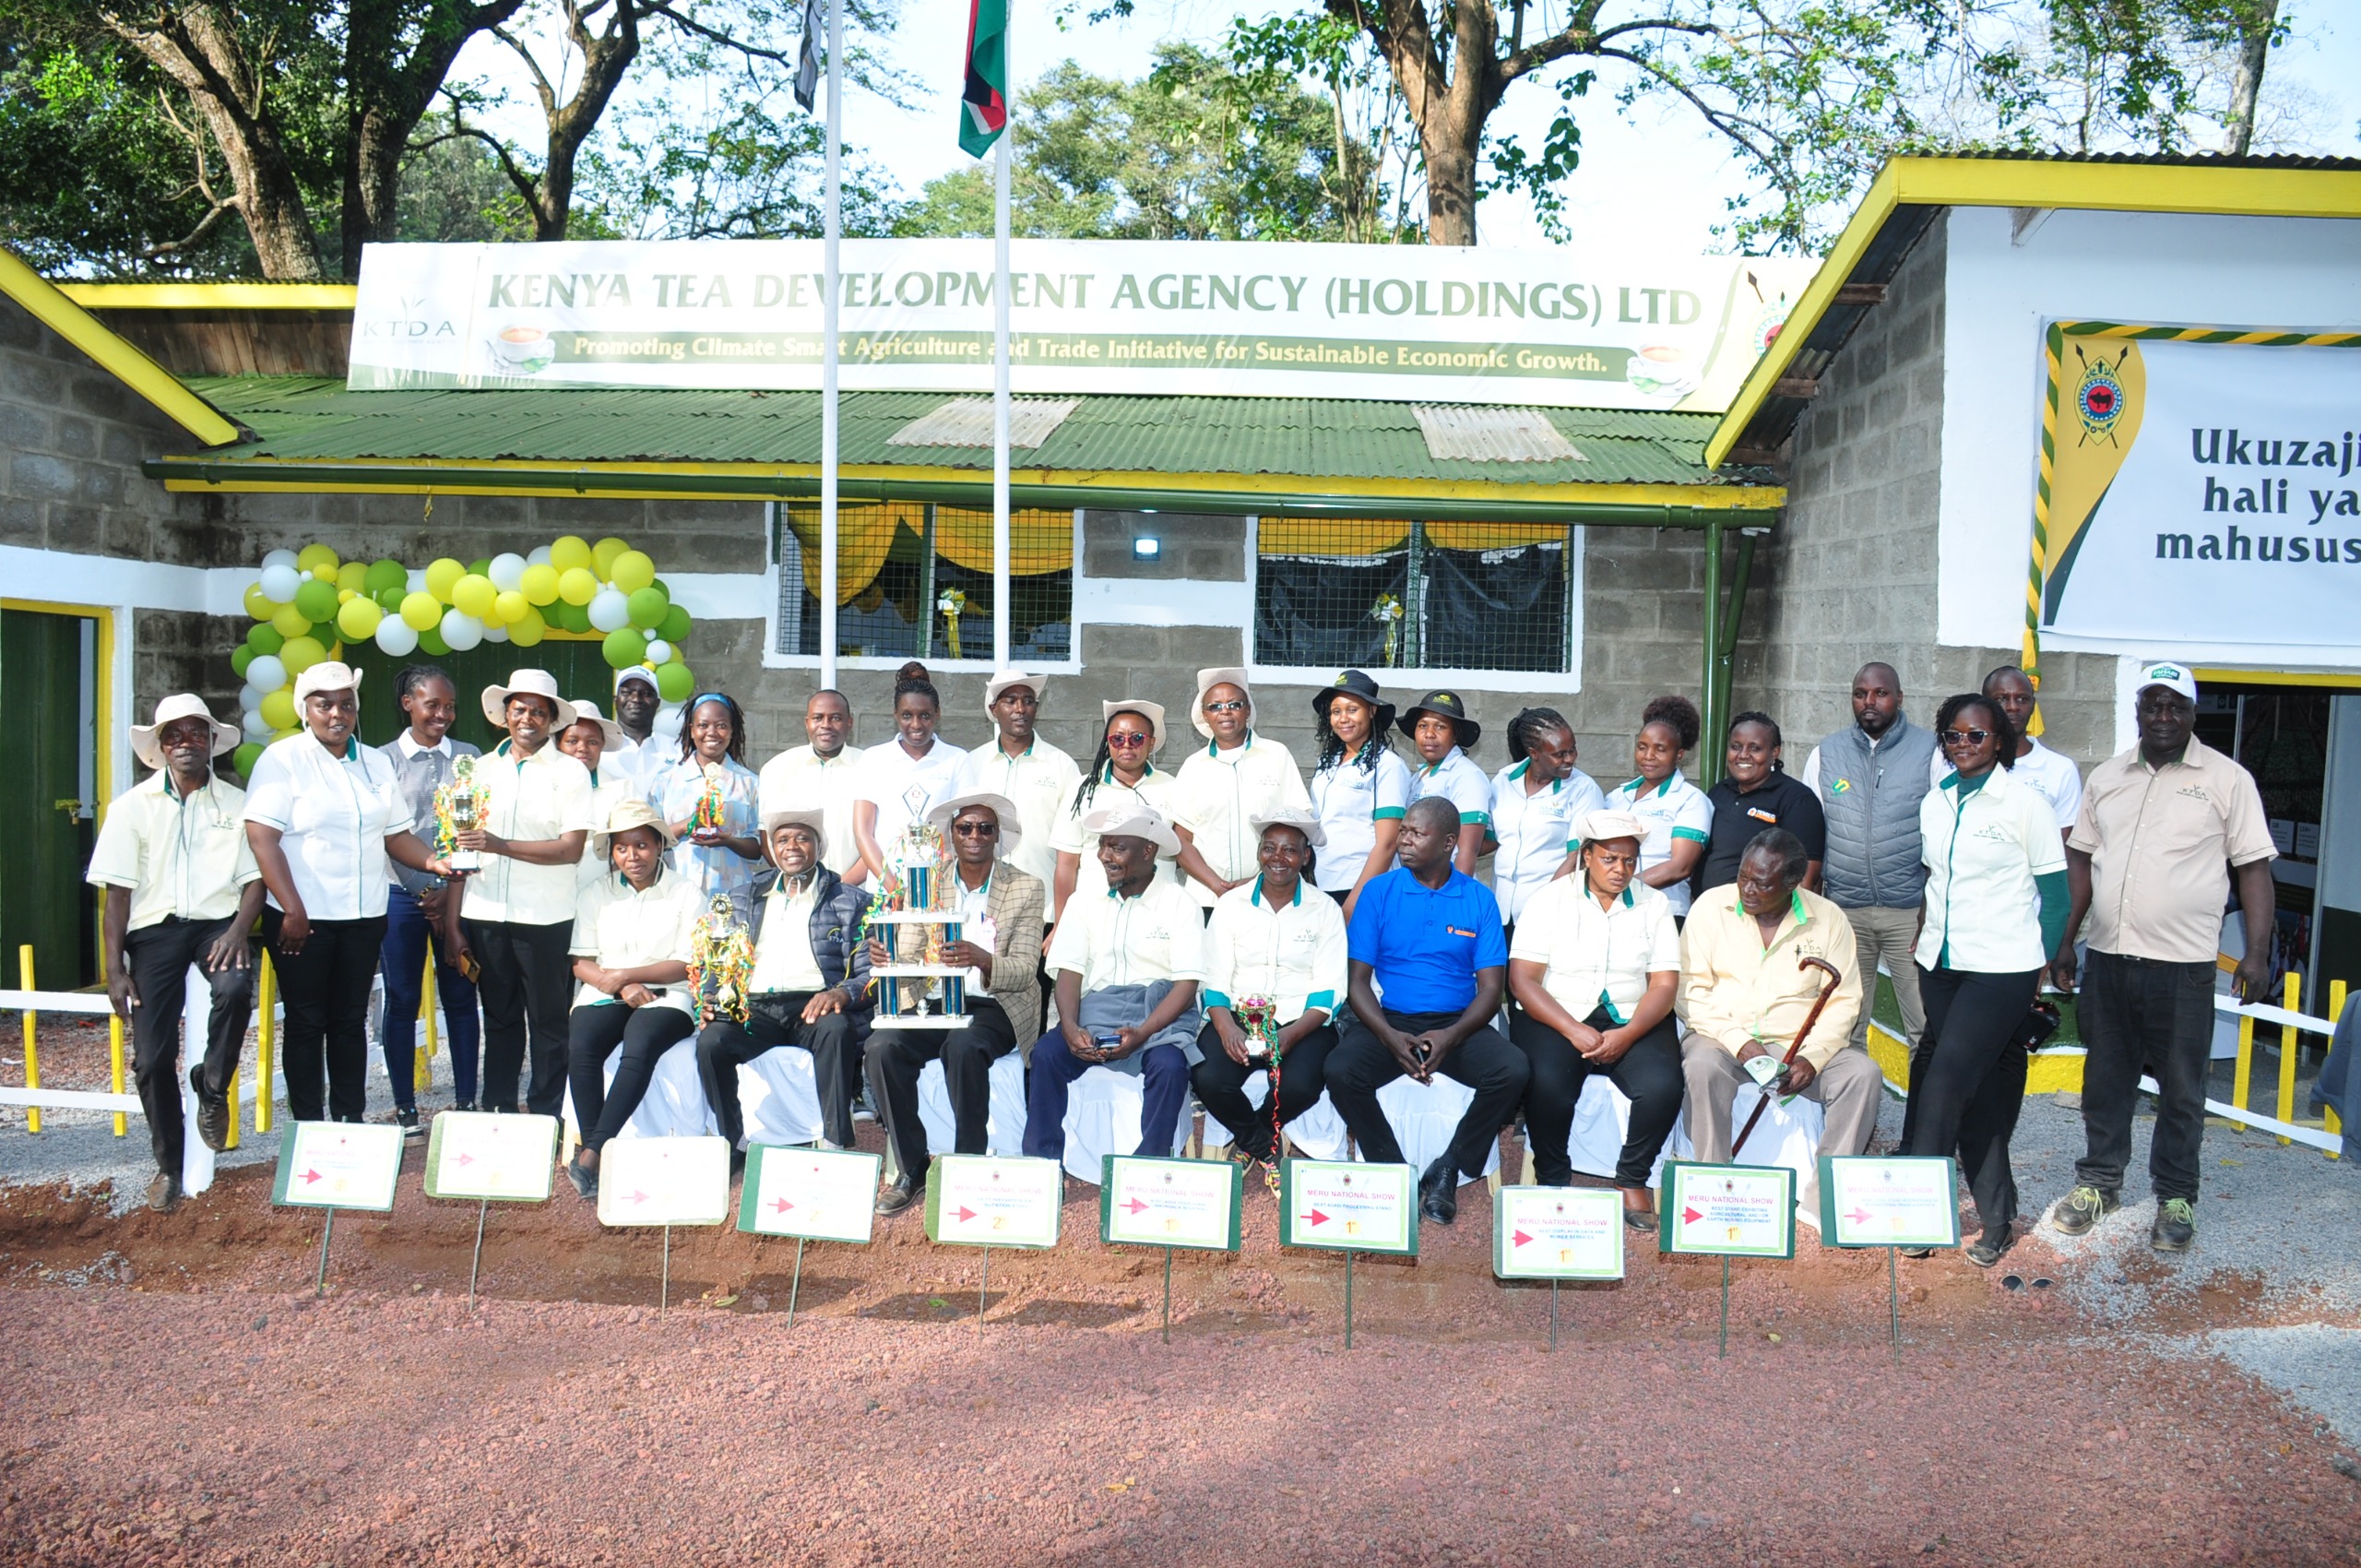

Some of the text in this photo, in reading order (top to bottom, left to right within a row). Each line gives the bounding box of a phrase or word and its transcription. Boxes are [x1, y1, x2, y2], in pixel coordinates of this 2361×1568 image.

[488, 271, 1702, 327] KENYA TEA DEVELOPMENT AGENCY (HOLDINGS) LTD
[362, 320, 457, 337] KTDA
[575, 337, 685, 360] Promoting
[692, 337, 776, 356] Climate
[782, 337, 846, 357] Smat
[854, 337, 980, 360] Agriculture
[1038, 339, 1100, 358] Trade
[1108, 339, 1207, 359] Initiative
[1216, 340, 1249, 360] for
[1255, 341, 1389, 365] Sustainable
[1397, 347, 1509, 368] Economic
[1516, 350, 1608, 372] Growth.
[2203, 477, 2361, 526] hali ya
[2155, 526, 2361, 564] mahusus
[1150, 1187, 1187, 1196] NATIONAL
[1331, 1191, 1370, 1199] NATIONAL
